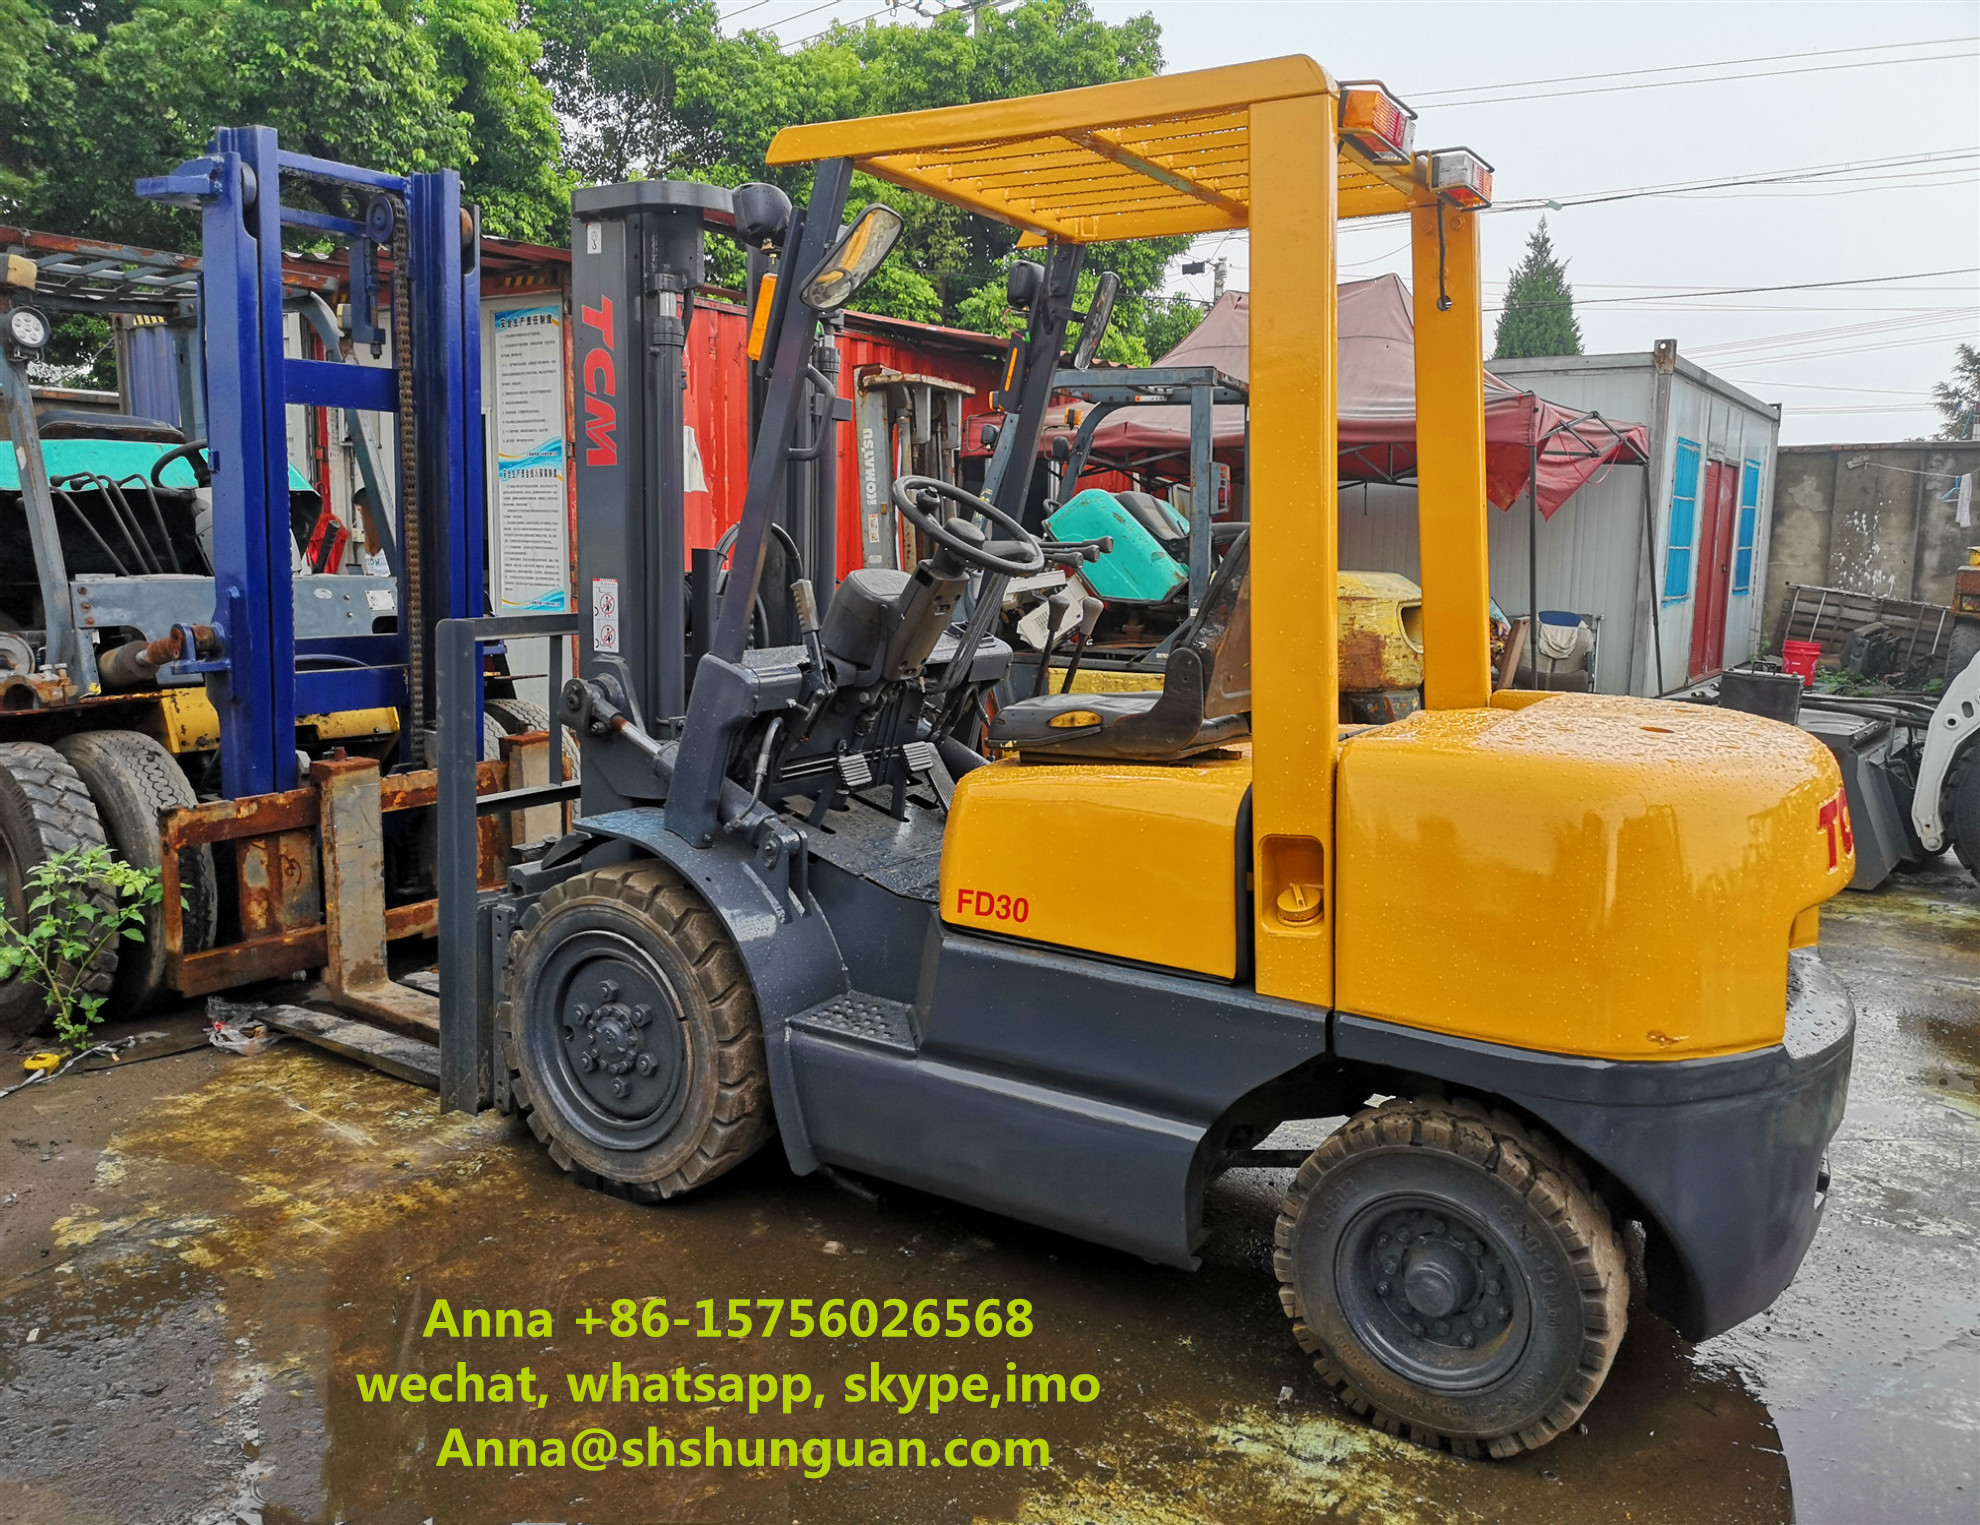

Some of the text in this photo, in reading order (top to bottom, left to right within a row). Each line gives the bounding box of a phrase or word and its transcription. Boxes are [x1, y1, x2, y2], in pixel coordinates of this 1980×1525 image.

[581, 294, 618, 467] TCM
[861, 427, 878, 506] KOMATSU
[956, 888, 1030, 923] FD30
